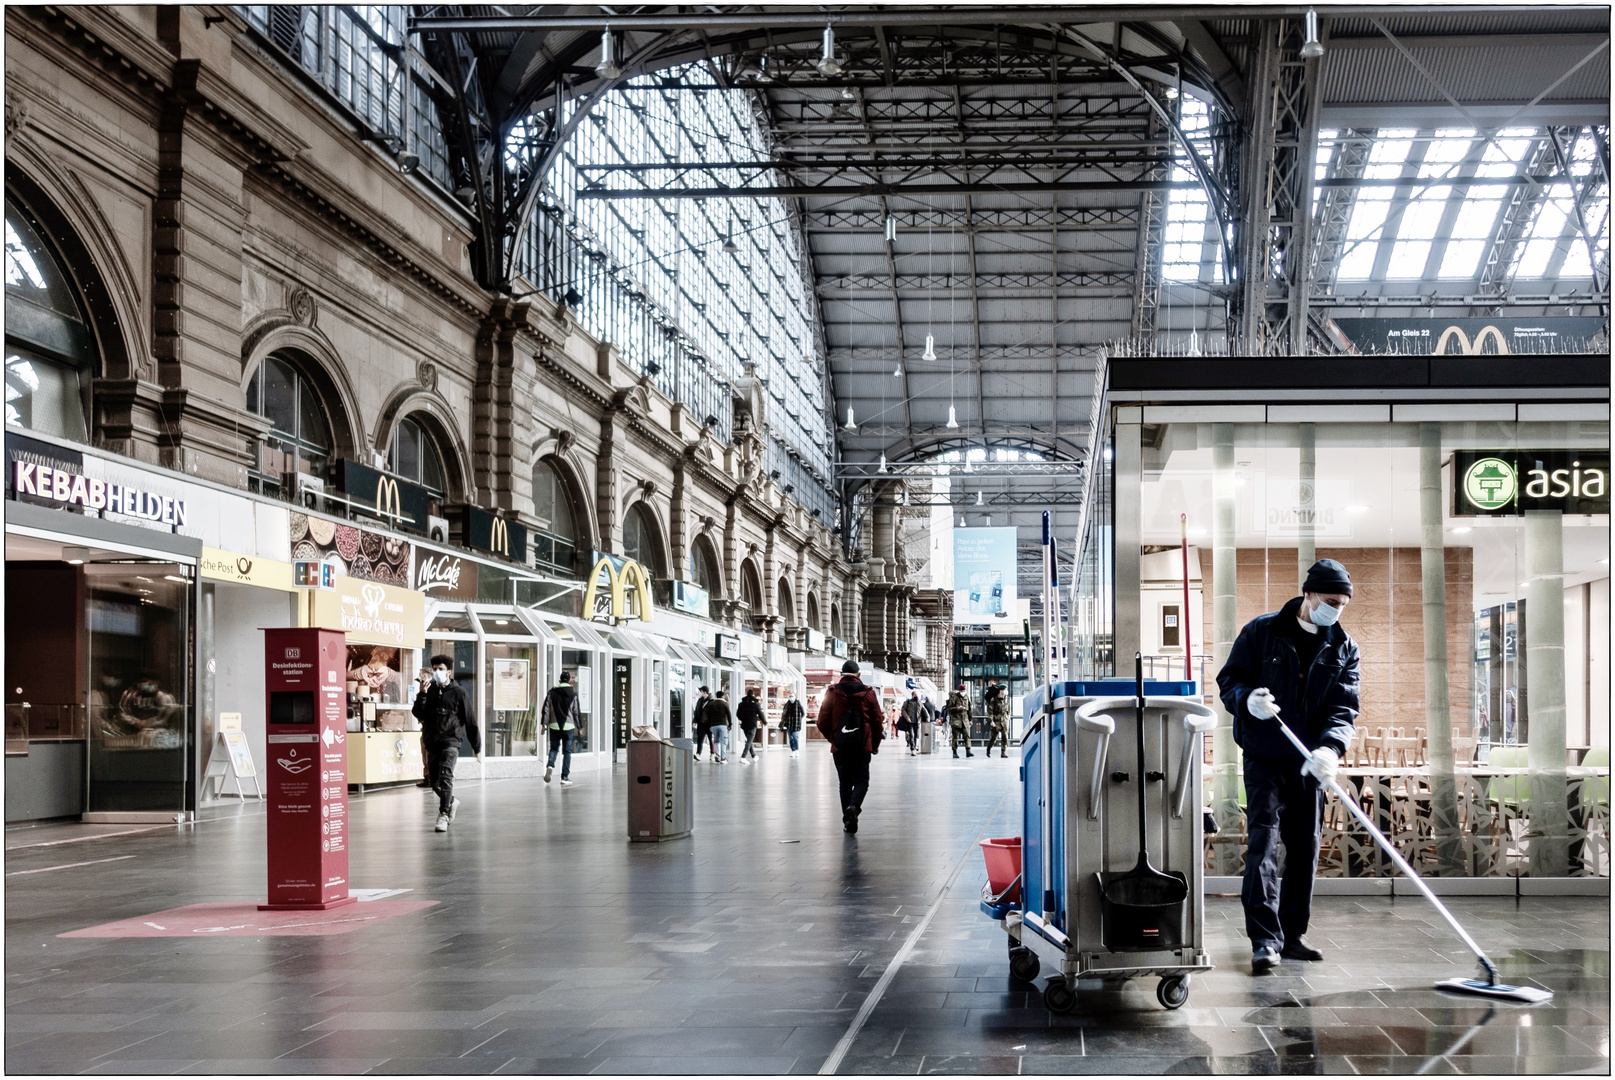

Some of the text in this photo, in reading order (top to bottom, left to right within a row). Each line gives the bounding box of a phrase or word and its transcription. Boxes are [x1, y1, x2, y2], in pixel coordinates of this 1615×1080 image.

[1402, 329, 1420, 337] Gleis
[16, 460, 188, 527] KEBABHELDEN
[1526, 461, 1604, 498] asia
[218, 561, 234, 574] Post
[418, 554, 460, 591] McCafé
[286, 648, 299, 658] DB
[665, 770, 673, 823] Abfall
